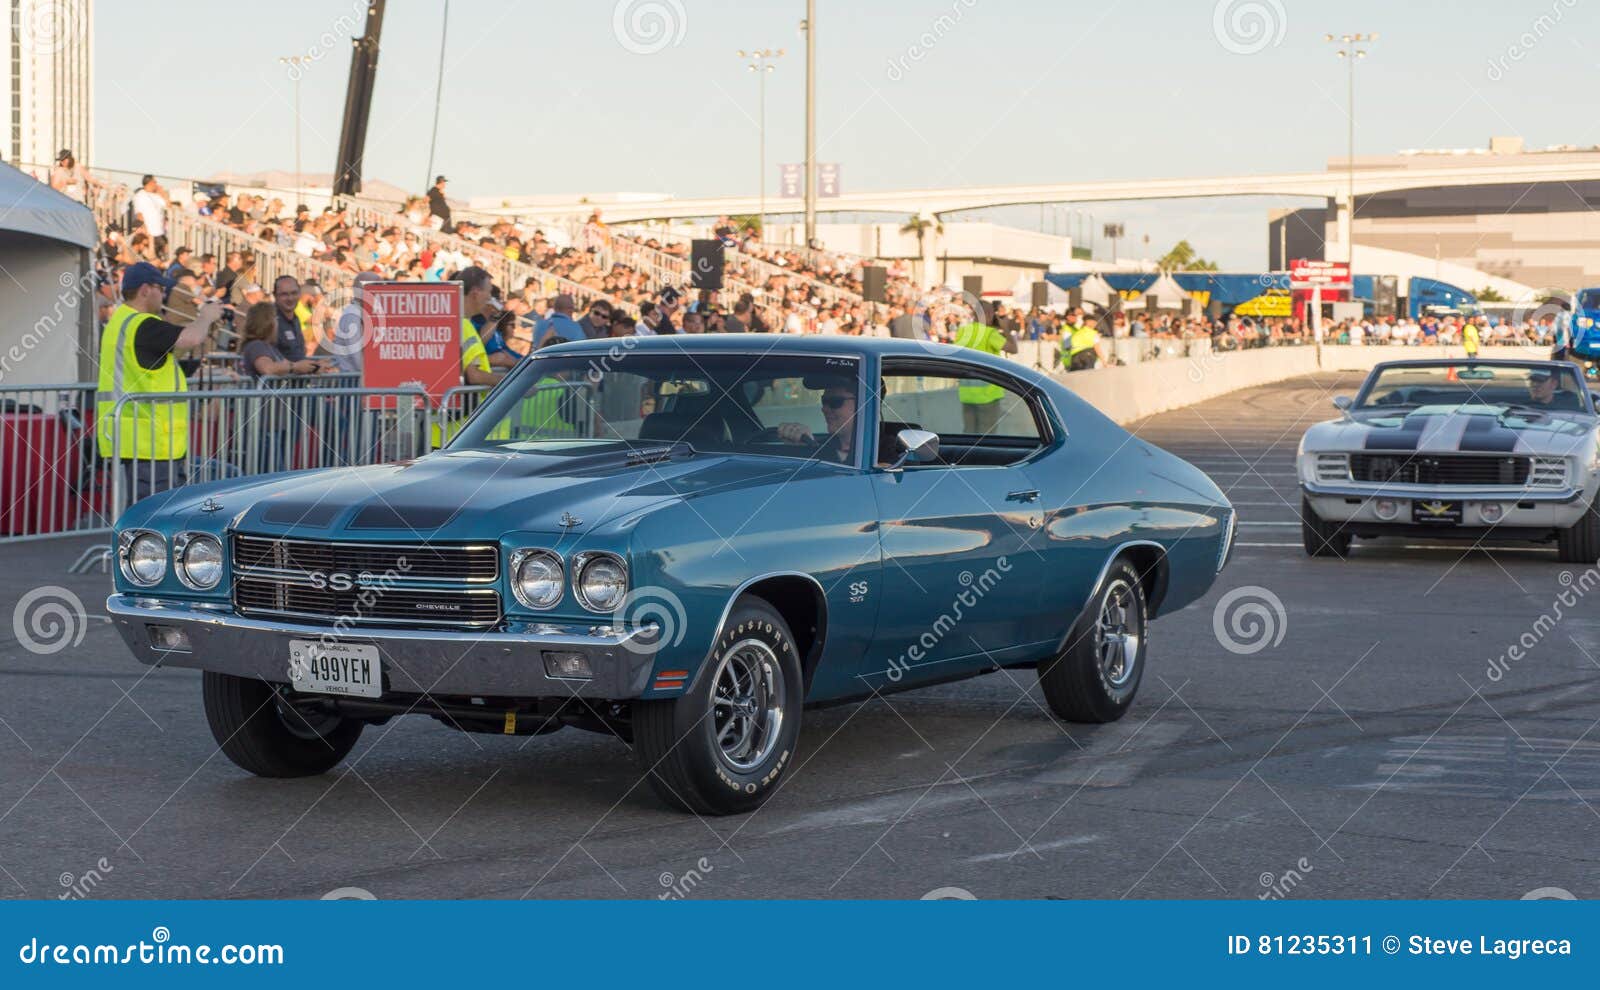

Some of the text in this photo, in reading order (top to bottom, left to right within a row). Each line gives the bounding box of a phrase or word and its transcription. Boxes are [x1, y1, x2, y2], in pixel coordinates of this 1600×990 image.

[372, 293, 451, 315] ATTENTION
[373, 326, 452, 342] CREDENTIALED
[380, 343, 446, 360] MEDIA ONLY
[309, 571, 354, 591] SS
[849, 581, 868, 596] SS
[415, 603, 461, 611] CHEVELLE
[311, 655, 372, 685] 499YEM
[325, 685, 349, 693] VEHICLE
